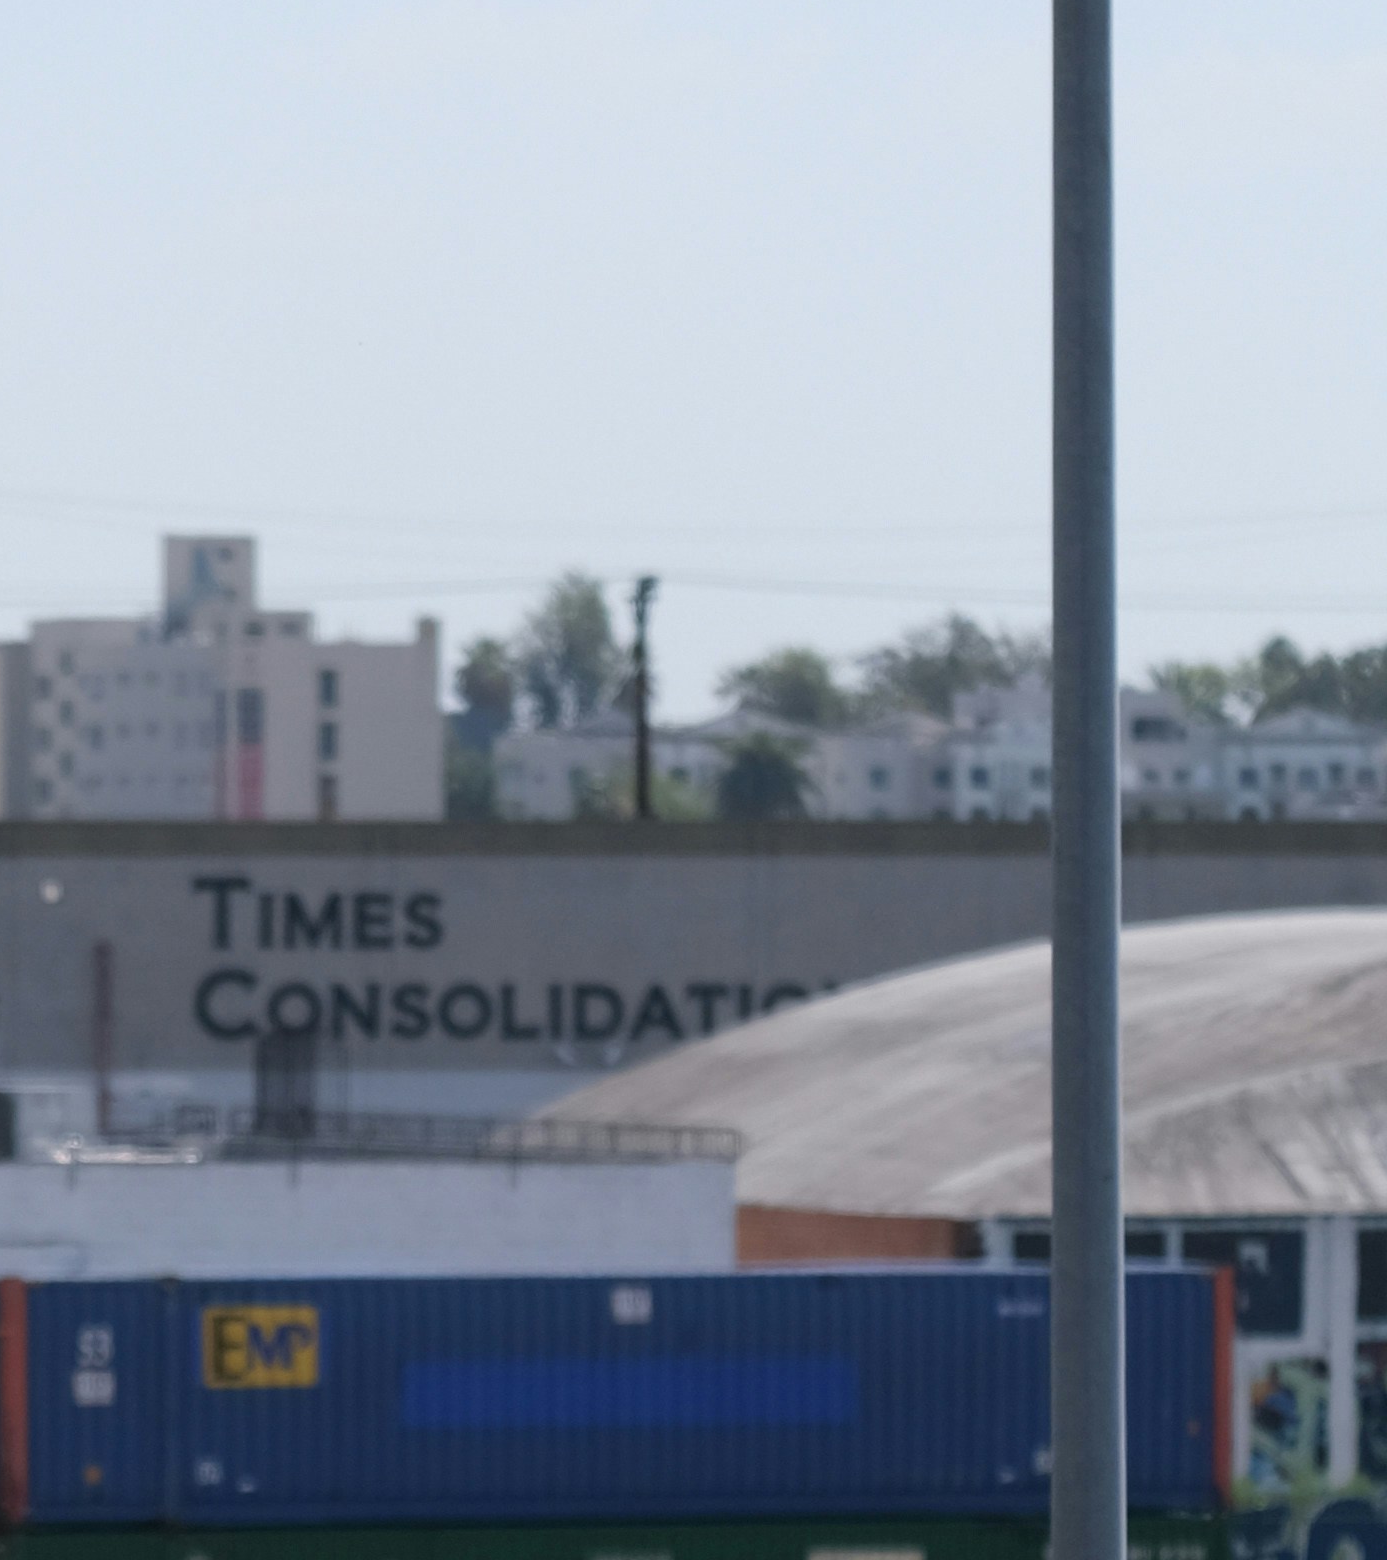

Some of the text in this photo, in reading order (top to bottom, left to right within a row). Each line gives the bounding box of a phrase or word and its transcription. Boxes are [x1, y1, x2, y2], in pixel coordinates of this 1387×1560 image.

[191, 876, 443, 950] TIMES
[192, 969, 839, 1043] CONSOLIDATI
[210, 1313, 314, 1383] EMP
